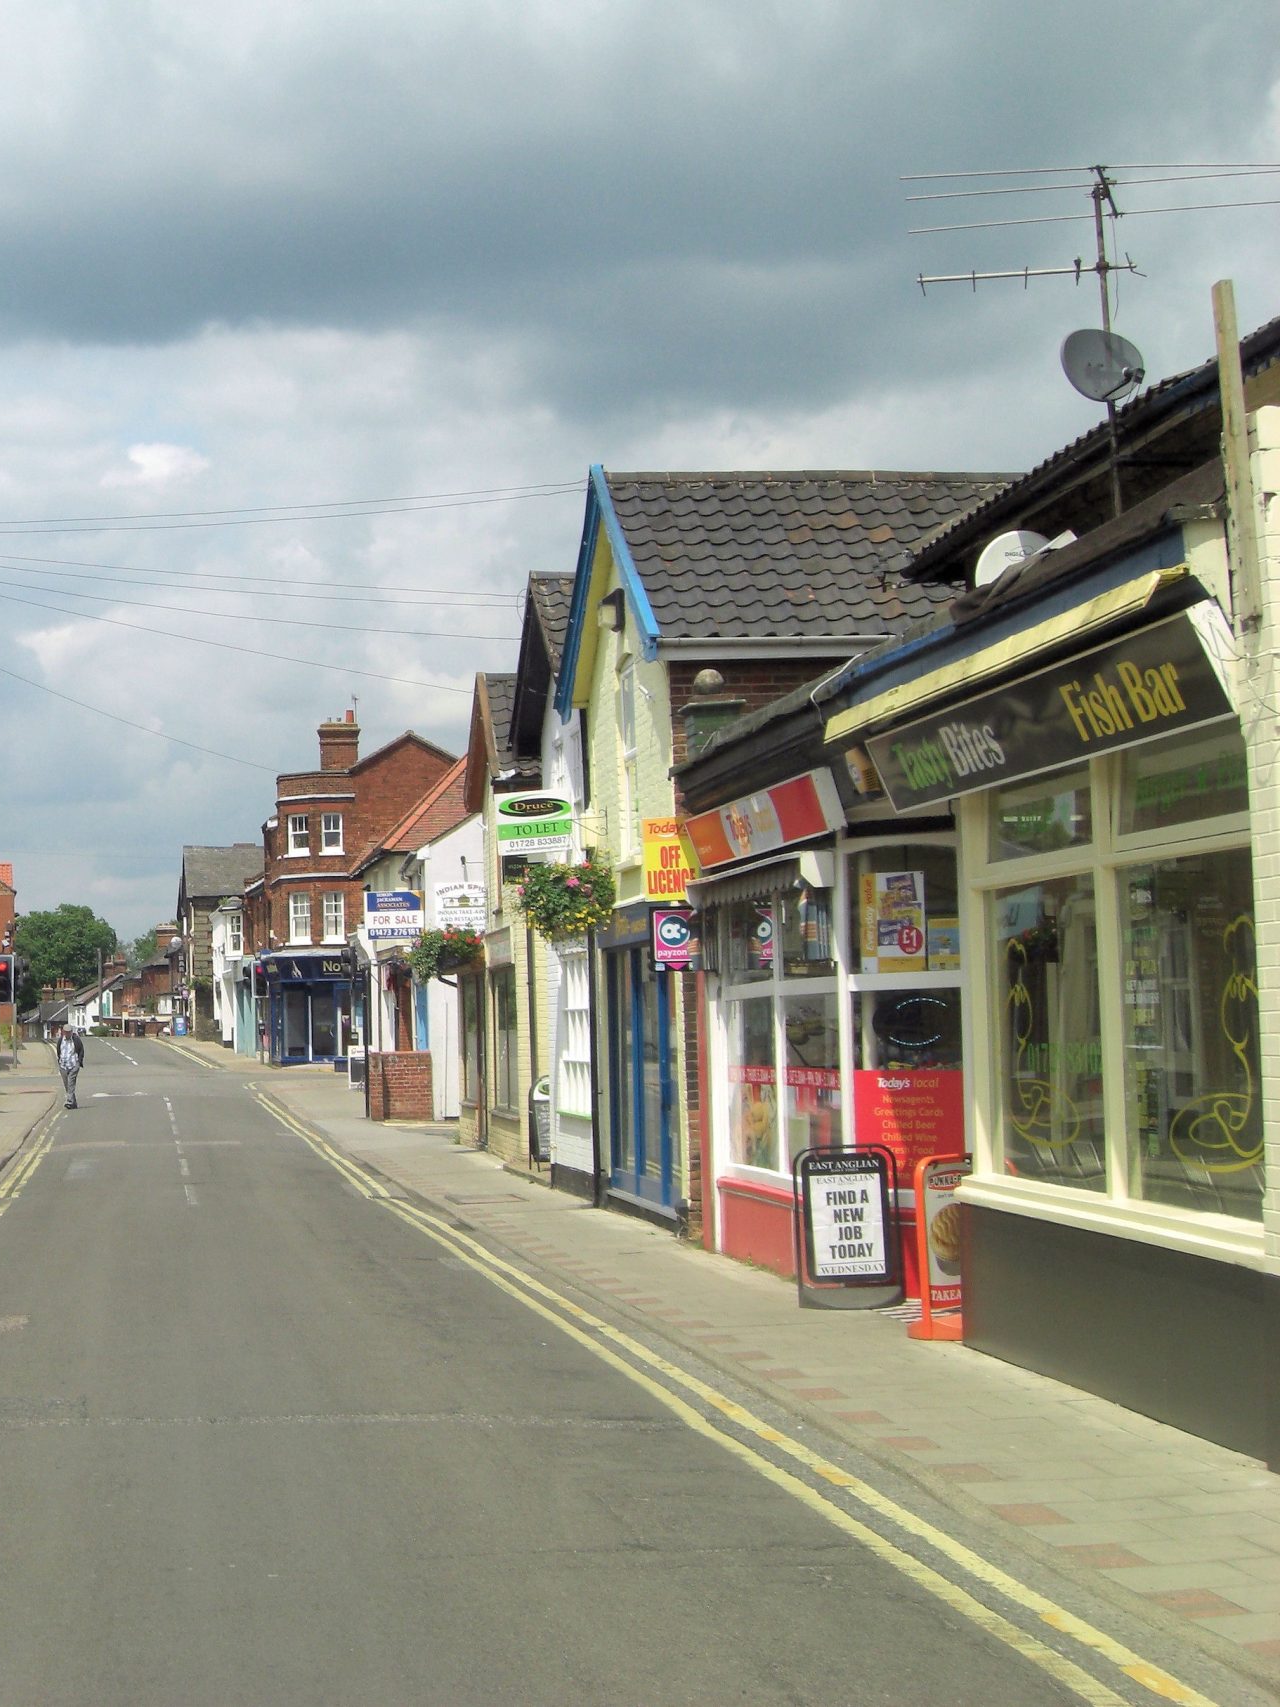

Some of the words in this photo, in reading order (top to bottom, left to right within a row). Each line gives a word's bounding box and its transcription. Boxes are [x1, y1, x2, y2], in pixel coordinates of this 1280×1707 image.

[1059, 674, 1134, 742] Fish
[1116, 660, 1186, 723] Bar
[891, 737, 955, 791] Tasty
[939, 722, 1006, 777] Bites
[514, 801, 554, 811] Druce
[514, 825, 532, 836] TO
[536, 822, 559, 833] LET
[509, 839, 535, 848] 01728
[660, 845, 681, 869] OFF
[435, 884, 464, 896] INDIAN
[467, 884, 488, 894] SPIC
[373, 915, 391, 925] FOR
[395, 915, 418, 925] SALE
[370, 928, 392, 936] 01473
[902, 929, 917, 947] £1
[657, 949, 688, 958] payzon
[877, 1077, 911, 1090] Today's
[913, 1077, 939, 1088] local
[882, 1095, 934, 1106] Newsagents
[874, 1107, 917, 1118] Greetings
[919, 1107, 944, 1117] Cards
[882, 1120, 913, 1129] Chilled
[915, 1120, 936, 1129] Beer
[881, 1133, 913, 1142] Chilled
[915, 1133, 938, 1142] Wine
[913, 1145, 934, 1155] Food
[809, 1161, 834, 1171] EAST
[835, 1159, 879, 1170] ANGLIAN
[817, 1177, 837, 1185] EAST
[838, 1173, 875, 1183] ANGLIAN
[929, 1174, 962, 1186] PUKKA-P
[826, 1190, 857, 1206] FIND
[860, 1189, 870, 1204] A
[833, 1207, 864, 1223] NEW
[838, 1225, 863, 1241] JOB
[829, 1243, 874, 1260] TODAY
[820, 1263, 885, 1275] WEDNESDAY
[930, 1290, 962, 1302] TAKEA
